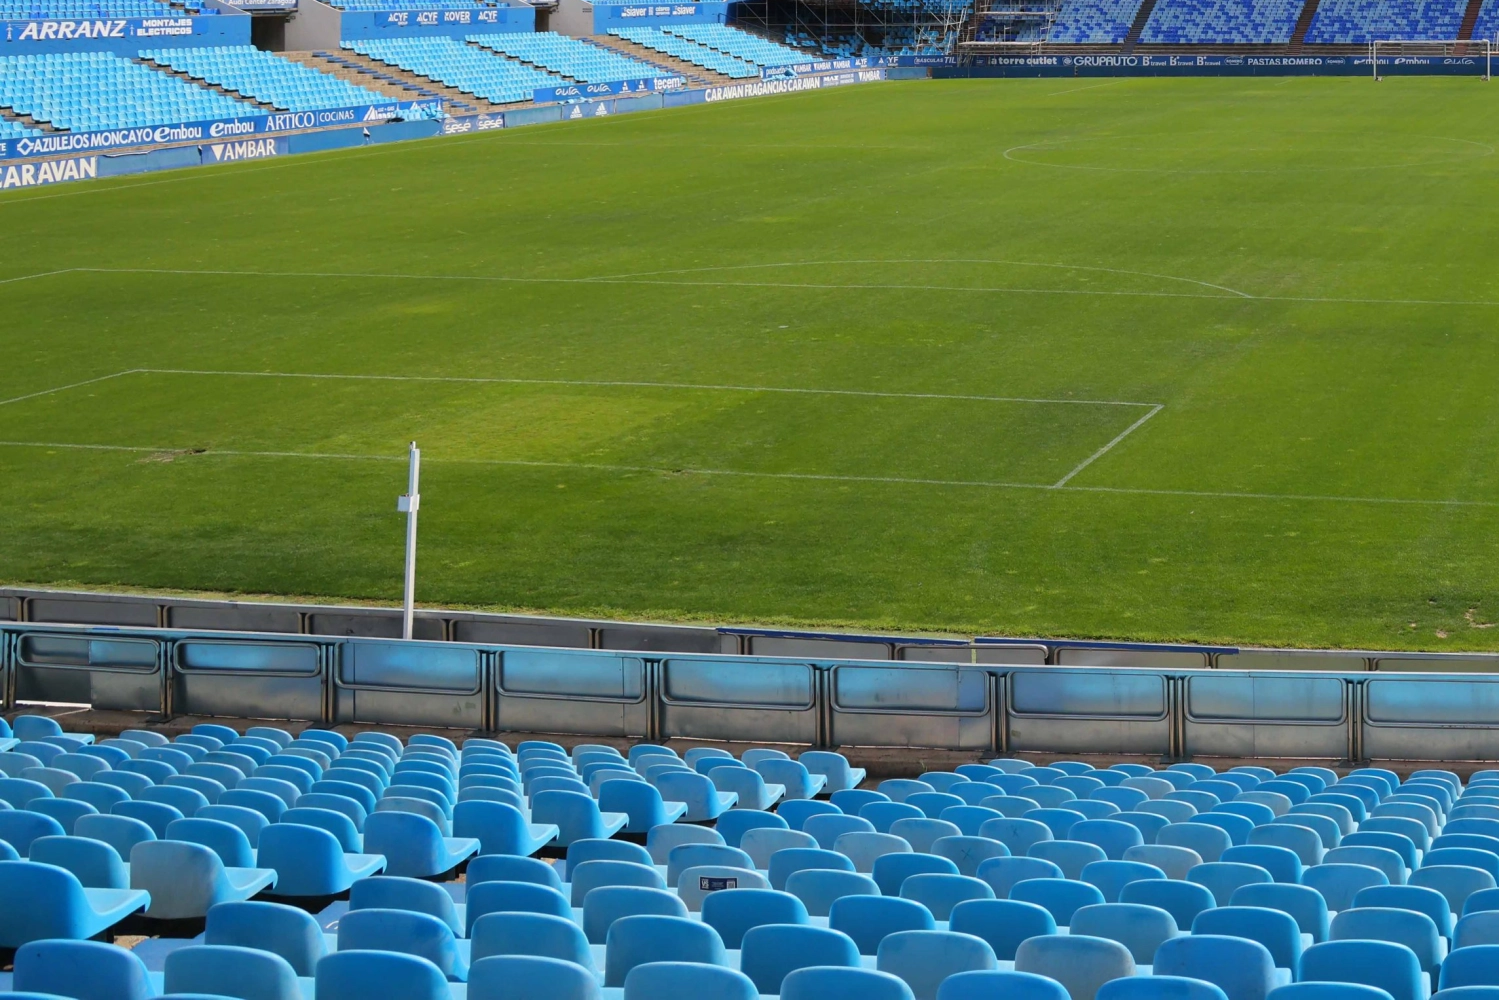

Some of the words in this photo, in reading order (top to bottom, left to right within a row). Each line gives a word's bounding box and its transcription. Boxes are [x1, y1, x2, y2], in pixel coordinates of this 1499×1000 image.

[388, 12, 408, 22] ACYF
[417, 12, 438, 22] ACYF
[478, 11, 497, 20] ACYF
[143, 19, 192, 27] MONTAJES
[19, 20, 127, 40] ARRANZ
[137, 27, 192, 36] ELECTRICOS
[998, 57, 1025, 65] torre
[1026, 56, 1057, 65] outlet
[1074, 56, 1138, 66] GRUPAUTO
[1247, 58, 1281, 66] PASTAS
[1282, 58, 1323, 66] ROMERO
[863, 70, 880, 81] AMBAR
[705, 86, 744, 102] CARAVAN
[744, 80, 787, 97] FRAGANCIAS
[788, 76, 821, 92] CARAVAN
[33, 134, 90, 153] AZULEJOS
[90, 128, 153, 147] MONCAYO
[154, 123, 202, 142] embou
[210, 119, 254, 137] embou
[265, 112, 315, 131] ARTICO
[319, 110, 355, 122] COCINAS
[223, 138, 277, 160] AMBAR
[0, 157, 96, 189] ARAVAN
